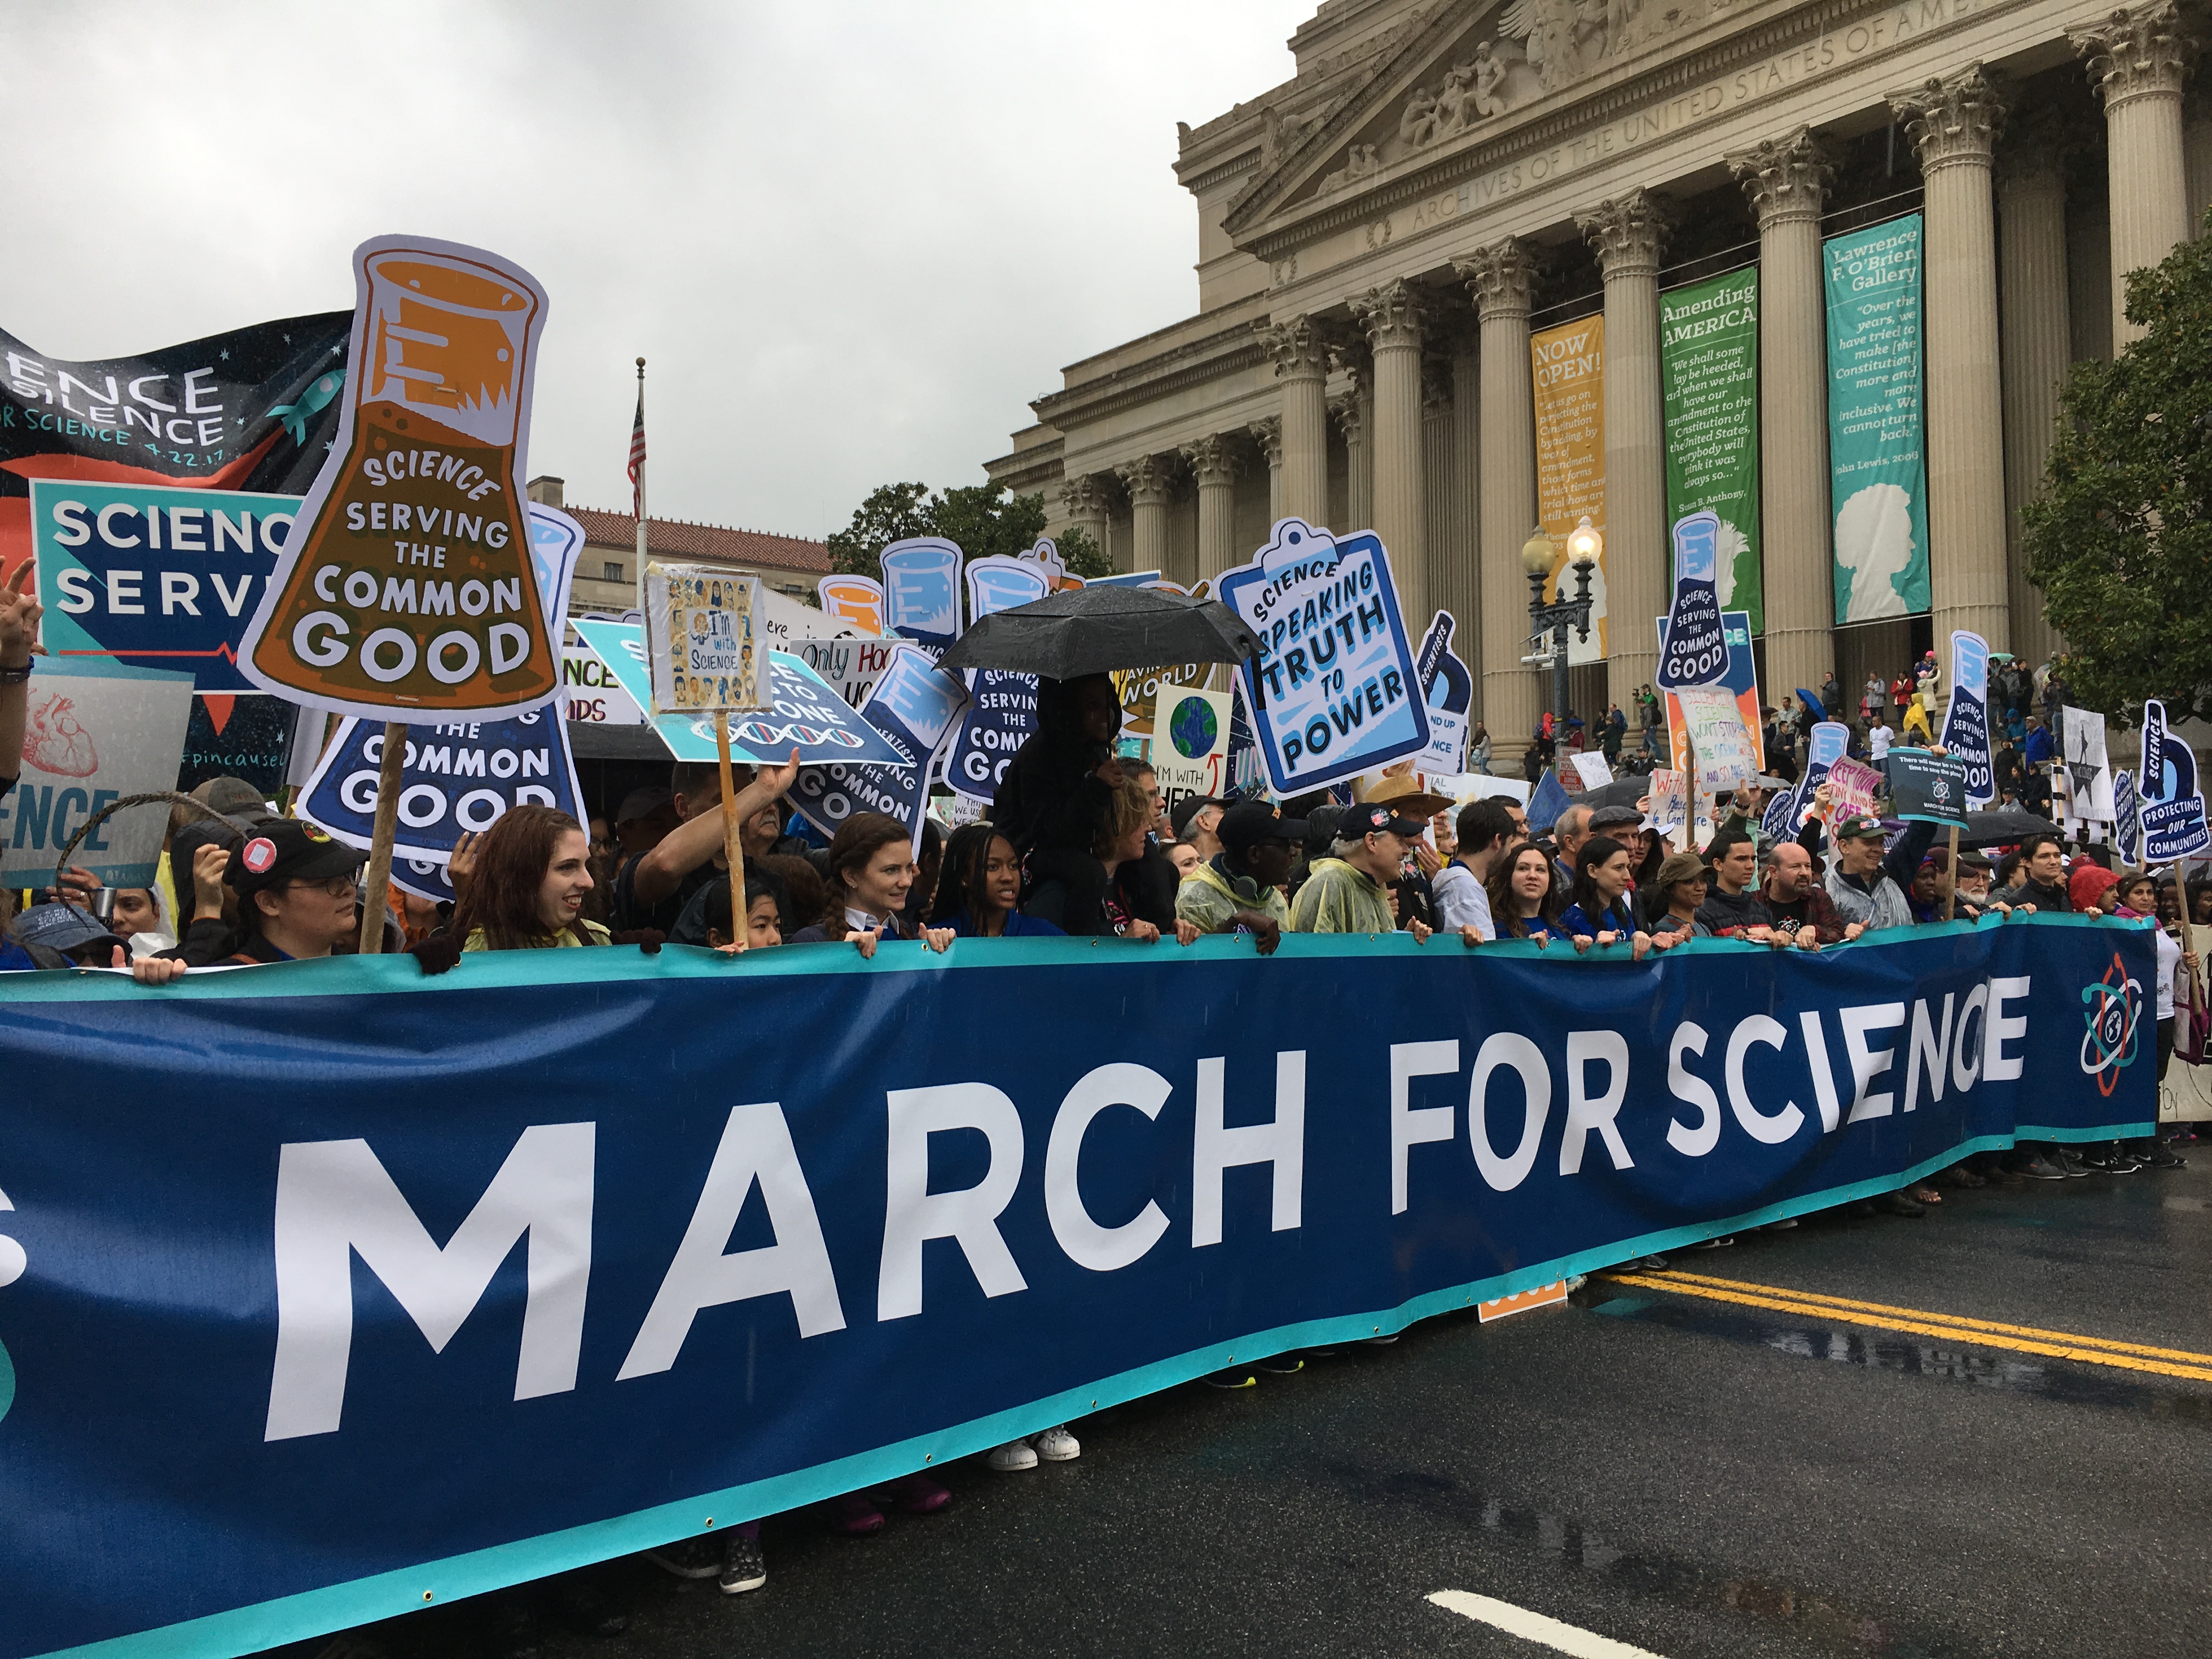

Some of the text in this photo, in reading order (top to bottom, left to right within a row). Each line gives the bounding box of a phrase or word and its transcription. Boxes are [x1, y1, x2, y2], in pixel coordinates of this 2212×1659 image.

[1413, 17, 1884, 229] ARCHIVES OF THE UNITED STATES OF
[1833, 230, 1917, 264] Lawrence
[1832, 249, 1917, 281] F. O'Brien
[1852, 266, 1917, 291] Gallery
[1662, 285, 1756, 324] Amending
[1895, 295, 1916, 308] the
[1663, 307, 1757, 348] AMERICA
[1857, 310, 1916, 334] years, we
[1536, 332, 1589, 366] NOW
[1839, 325, 1916, 351] have tried to
[1854, 338, 1917, 360] make [the
[1688, 357, 1743, 380] be heeded,
[1689, 349, 1714, 367] shall
[1716, 345, 1745, 359] some
[1836, 351, 1917, 380] Constitution]
[1538, 352, 1601, 387] OPEN!
[1682, 367, 1753, 395] when we shall
[1855, 365, 1917, 389] more and
[6, 351, 223, 414] ENCE
[1884, 384, 1917, 398] more
[1555, 391, 1591, 407] us go on
[1581, 400, 1598, 412] the
[1683, 390, 1728, 408] have our
[1722, 402, 1734, 410] to
[1736, 395, 1752, 408] the
[1839, 397, 1917, 421] inclusive. We
[12, 380, 224, 446] SILENCE
[1734, 409, 1747, 424] of
[1843, 413, 1918, 435] cannot turn
[24, 408, 223, 467] SCIENCE 4.22.17
[1541, 438, 1552, 450] by
[1585, 426, 1598, 439] by
[1669, 425, 1751, 453] the United States,
[1724, 437, 1744, 451] will
[1561, 444, 1570, 458] of
[1705, 455, 1736, 469] it was
[1835, 450, 1918, 476] John Lewis, 2006
[363, 450, 501, 501] SCIENCE
[1542, 468, 1592, 485] those forms
[1543, 481, 1590, 496] which time
[1543, 490, 1604, 510] trial are
[1697, 497, 1705, 506] B.
[1706, 489, 1747, 504] Anthony,
[53, 499, 296, 554] SCIENC
[346, 501, 509, 548] SERVING
[1544, 510, 1561, 522] still
[394, 541, 446, 568] THE
[56, 568, 269, 617] SERV
[314, 565, 521, 617] COMMON
[1254, 560, 1341, 623] SCIENCE
[1680, 589, 1713, 610] SCIENCE
[1260, 561, 1373, 658] SPEAKING
[1677, 608, 1716, 628] SERVING
[709, 610, 730, 635] I'm
[1689, 623, 1702, 635] THE
[292, 611, 530, 684] GOOD
[714, 635, 737, 651] with
[1262, 593, 1385, 696] TRUTH
[1671, 627, 1720, 656] COMMON
[691, 649, 738, 670] SCIENCE
[802, 641, 849, 680] Only
[1420, 623, 1447, 686] SCIENTISTS
[1667, 645, 1723, 679] GOOD
[777, 681, 818, 701] TO
[1321, 668, 1344, 698] TO
[1003, 713, 1026, 727] THE
[1283, 670, 1403, 772] POWER
[1443, 719, 1456, 729] UP
[1956, 702, 1983, 723] SCIENCE
[436, 723, 481, 740] THE
[1954, 719, 1985, 740] SERVING
[1963, 733, 1974, 745] THE
[363, 735, 549, 779] COMMON
[1948, 740, 1987, 764] COMMON
[2149, 715, 2160, 780] SCIENCE
[859, 763, 884, 784] THE
[1176, 768, 1204, 786] WITH
[1655, 770, 1700, 795] Withot
[1719, 766, 1730, 783] SO
[1730, 764, 1745, 780] ARE
[1827, 756, 1858, 786] KEEP
[340, 770, 556, 833] GOOD
[830, 763, 911, 822] OMMON
[1830, 783, 1875, 810] TINY HANDS
[2117, 789, 2134, 820] TRUTH
[1767, 795, 1794, 827] PURSUING
[1835, 802, 1862, 823] OFF
[2145, 799, 2200, 824] PROTECTING
[2168, 819, 2186, 834] OUR
[2149, 827, 2206, 855] COMMUNITIES
[264, 974, 2031, 1443] MARCH FOR SCIENCE
